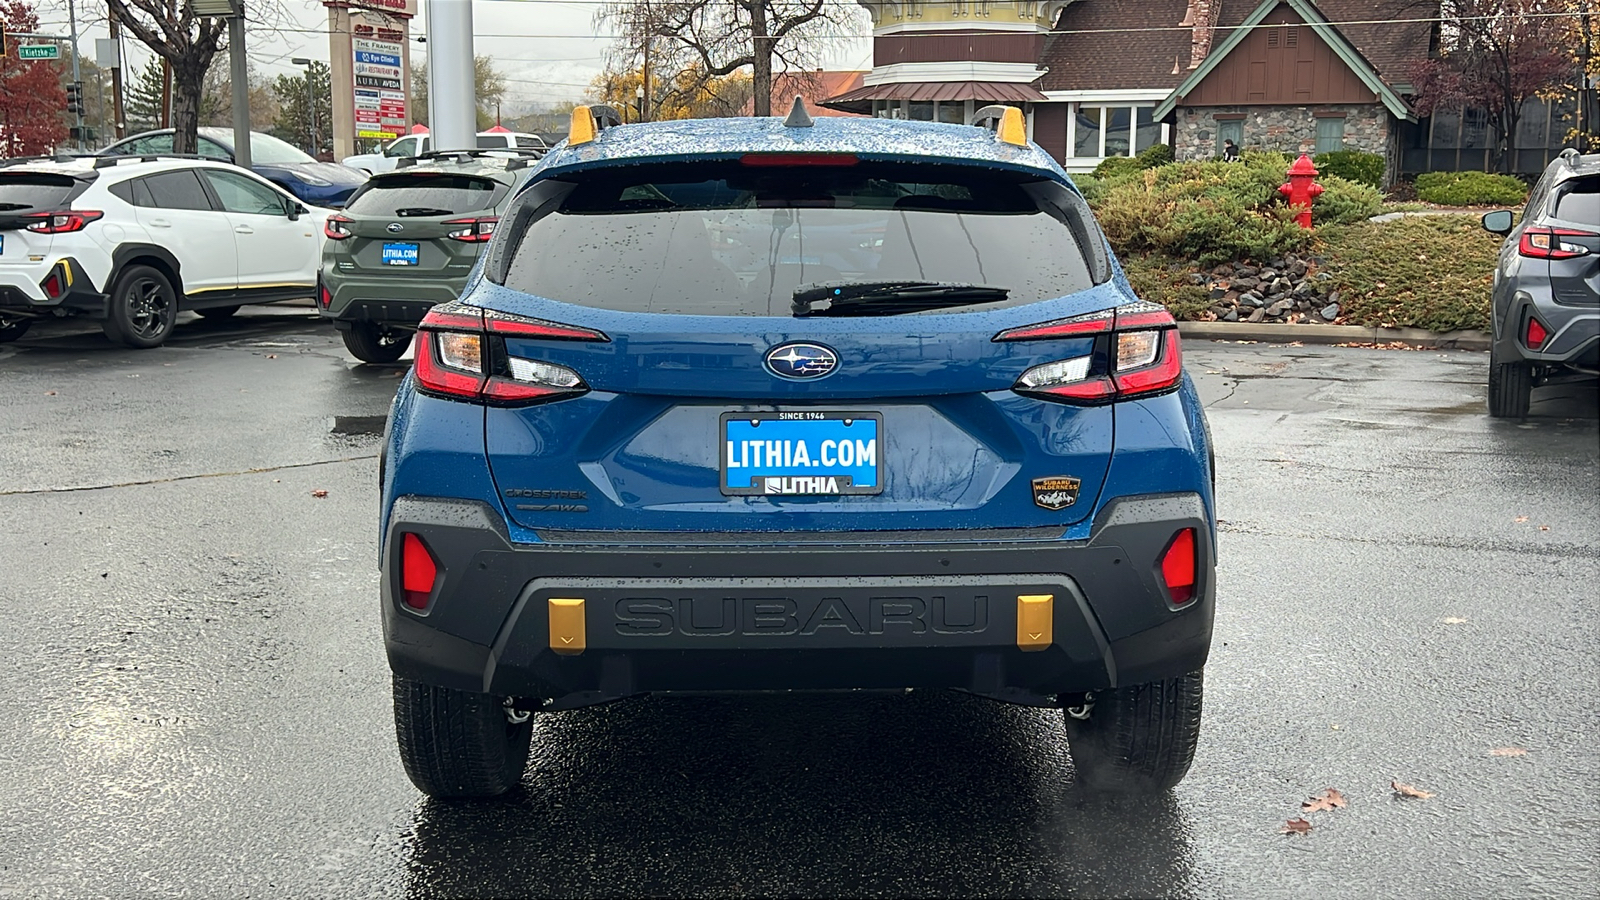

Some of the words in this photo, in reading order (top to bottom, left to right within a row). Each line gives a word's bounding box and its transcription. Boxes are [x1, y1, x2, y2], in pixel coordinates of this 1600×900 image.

[372, 42, 400, 50] FRAMERY
[25, 48, 48, 56] Kietzke
[357, 77, 378, 86] AURA
[382, 80, 400, 88] AVEDA
[382, 249, 418, 258] LITHIA.COM
[779, 412, 804, 420] SINCE
[806, 412, 825, 420] 1946
[727, 439, 877, 468] LITHIA.COM
[781, 477, 839, 494] LITHIA
[505, 488, 587, 500] CROSSTREK
[614, 596, 989, 636] SUBARU
